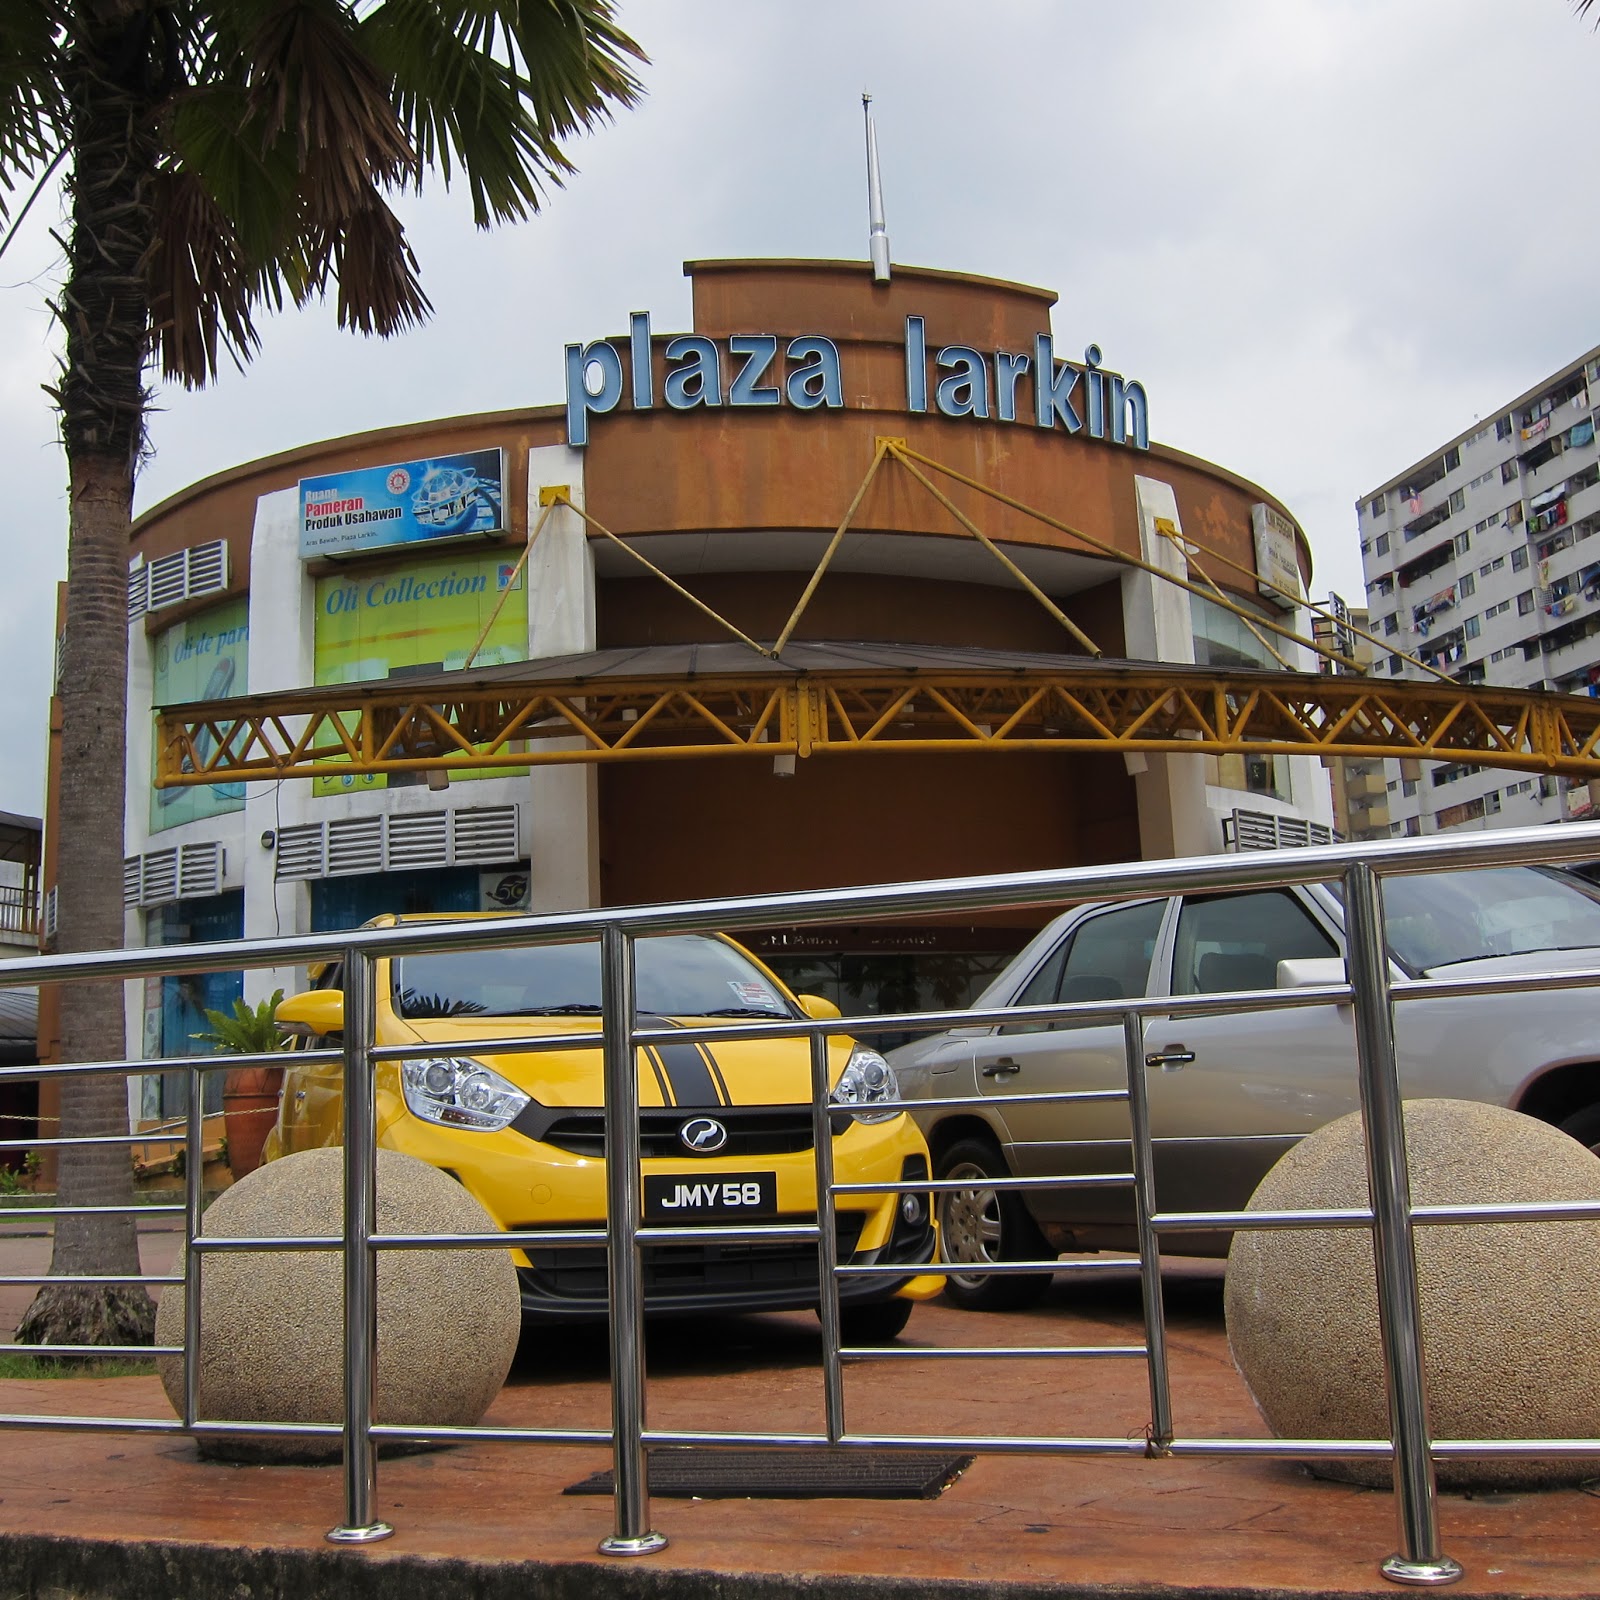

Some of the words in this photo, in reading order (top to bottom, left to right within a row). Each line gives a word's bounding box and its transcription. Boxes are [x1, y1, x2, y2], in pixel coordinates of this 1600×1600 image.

[564, 311, 844, 448] plaza
[905, 314, 1150, 451] larkin
[305, 488, 338, 501] Ruang
[305, 497, 363, 518] Pameran
[305, 514, 342, 531] Produk
[345, 507, 402, 525] Usahawan
[326, 585, 359, 615] Oli
[366, 570, 487, 608] Collection
[196, 631, 213, 656] de
